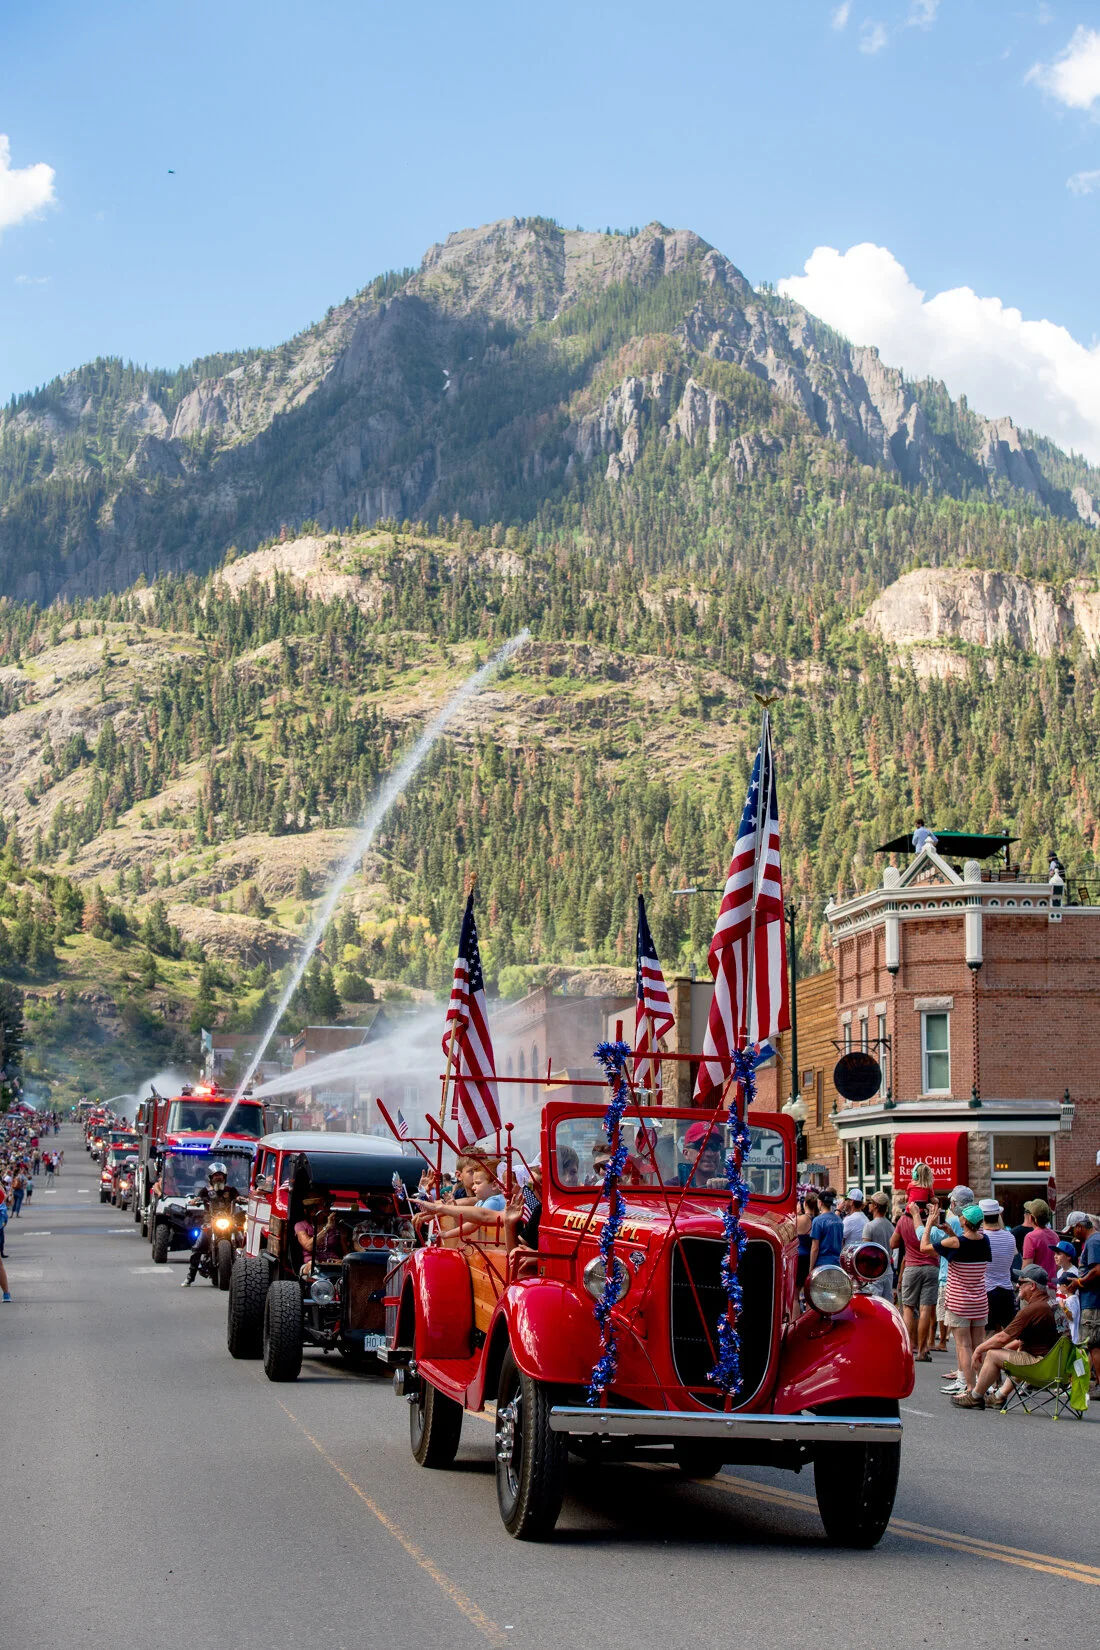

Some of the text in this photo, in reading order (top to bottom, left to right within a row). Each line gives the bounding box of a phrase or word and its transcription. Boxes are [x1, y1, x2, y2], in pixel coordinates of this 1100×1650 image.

[899, 1156, 951, 1165] THAI CHILI
[899, 1166, 952, 1175] RERANT
[563, 1212, 640, 1241] FIRE EPT.
